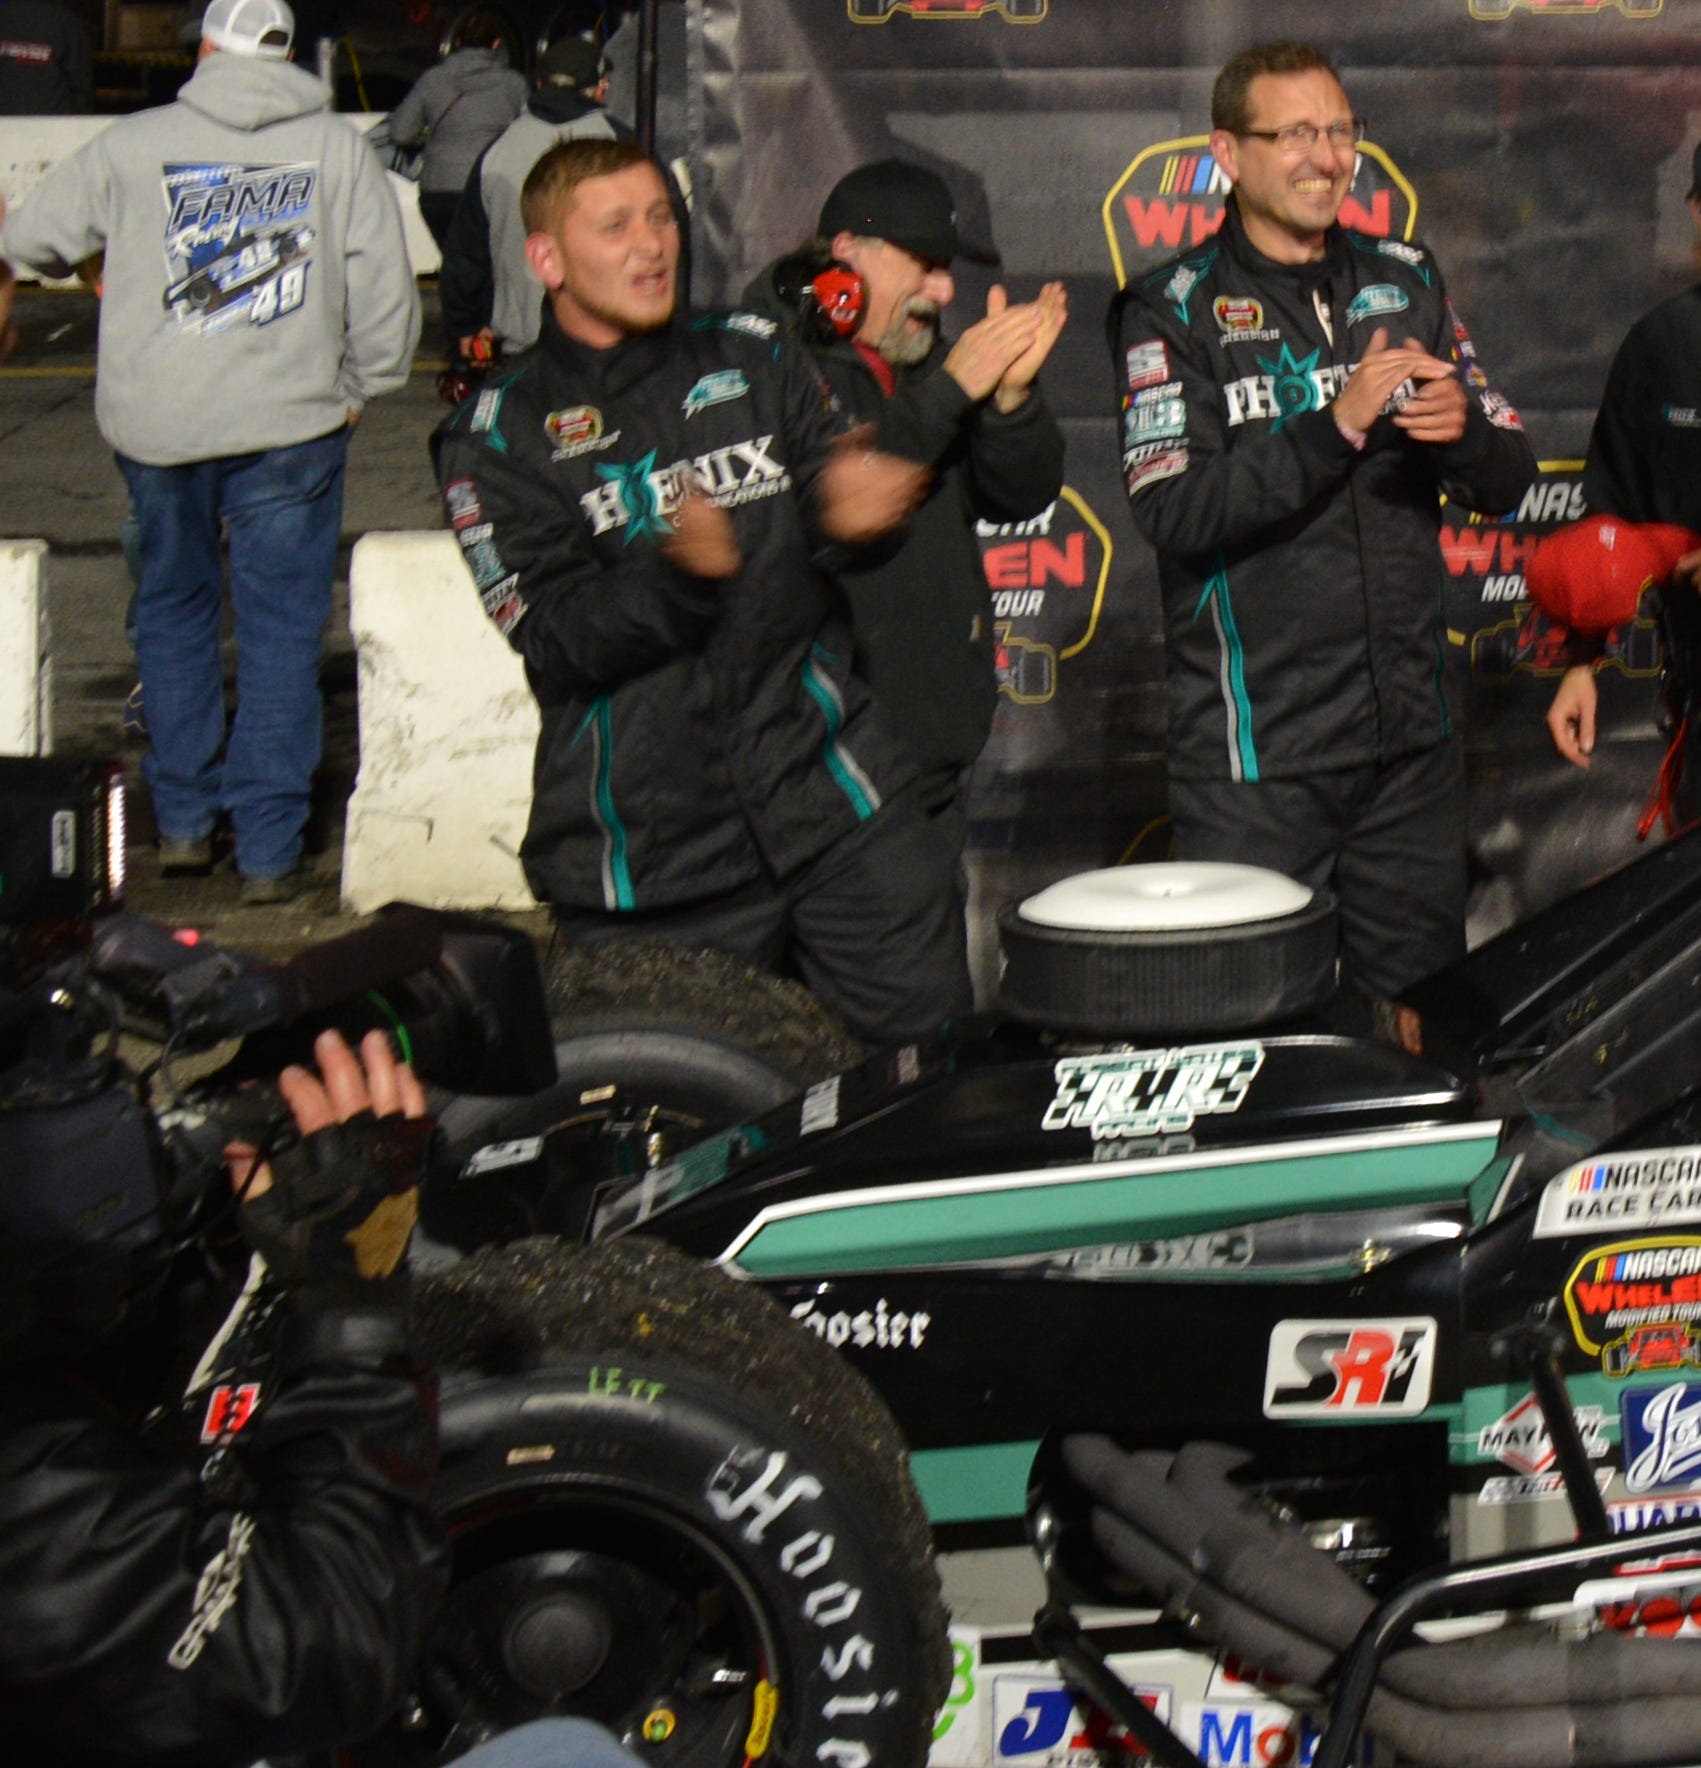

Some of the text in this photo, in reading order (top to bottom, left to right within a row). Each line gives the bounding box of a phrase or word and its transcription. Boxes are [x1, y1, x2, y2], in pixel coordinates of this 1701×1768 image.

[167, 170, 317, 235] FAMA
[250, 262, 312, 327] 49
[1565, 1195, 1639, 1223] RACE
[1604, 1306, 1669, 1331] MODIFIED
